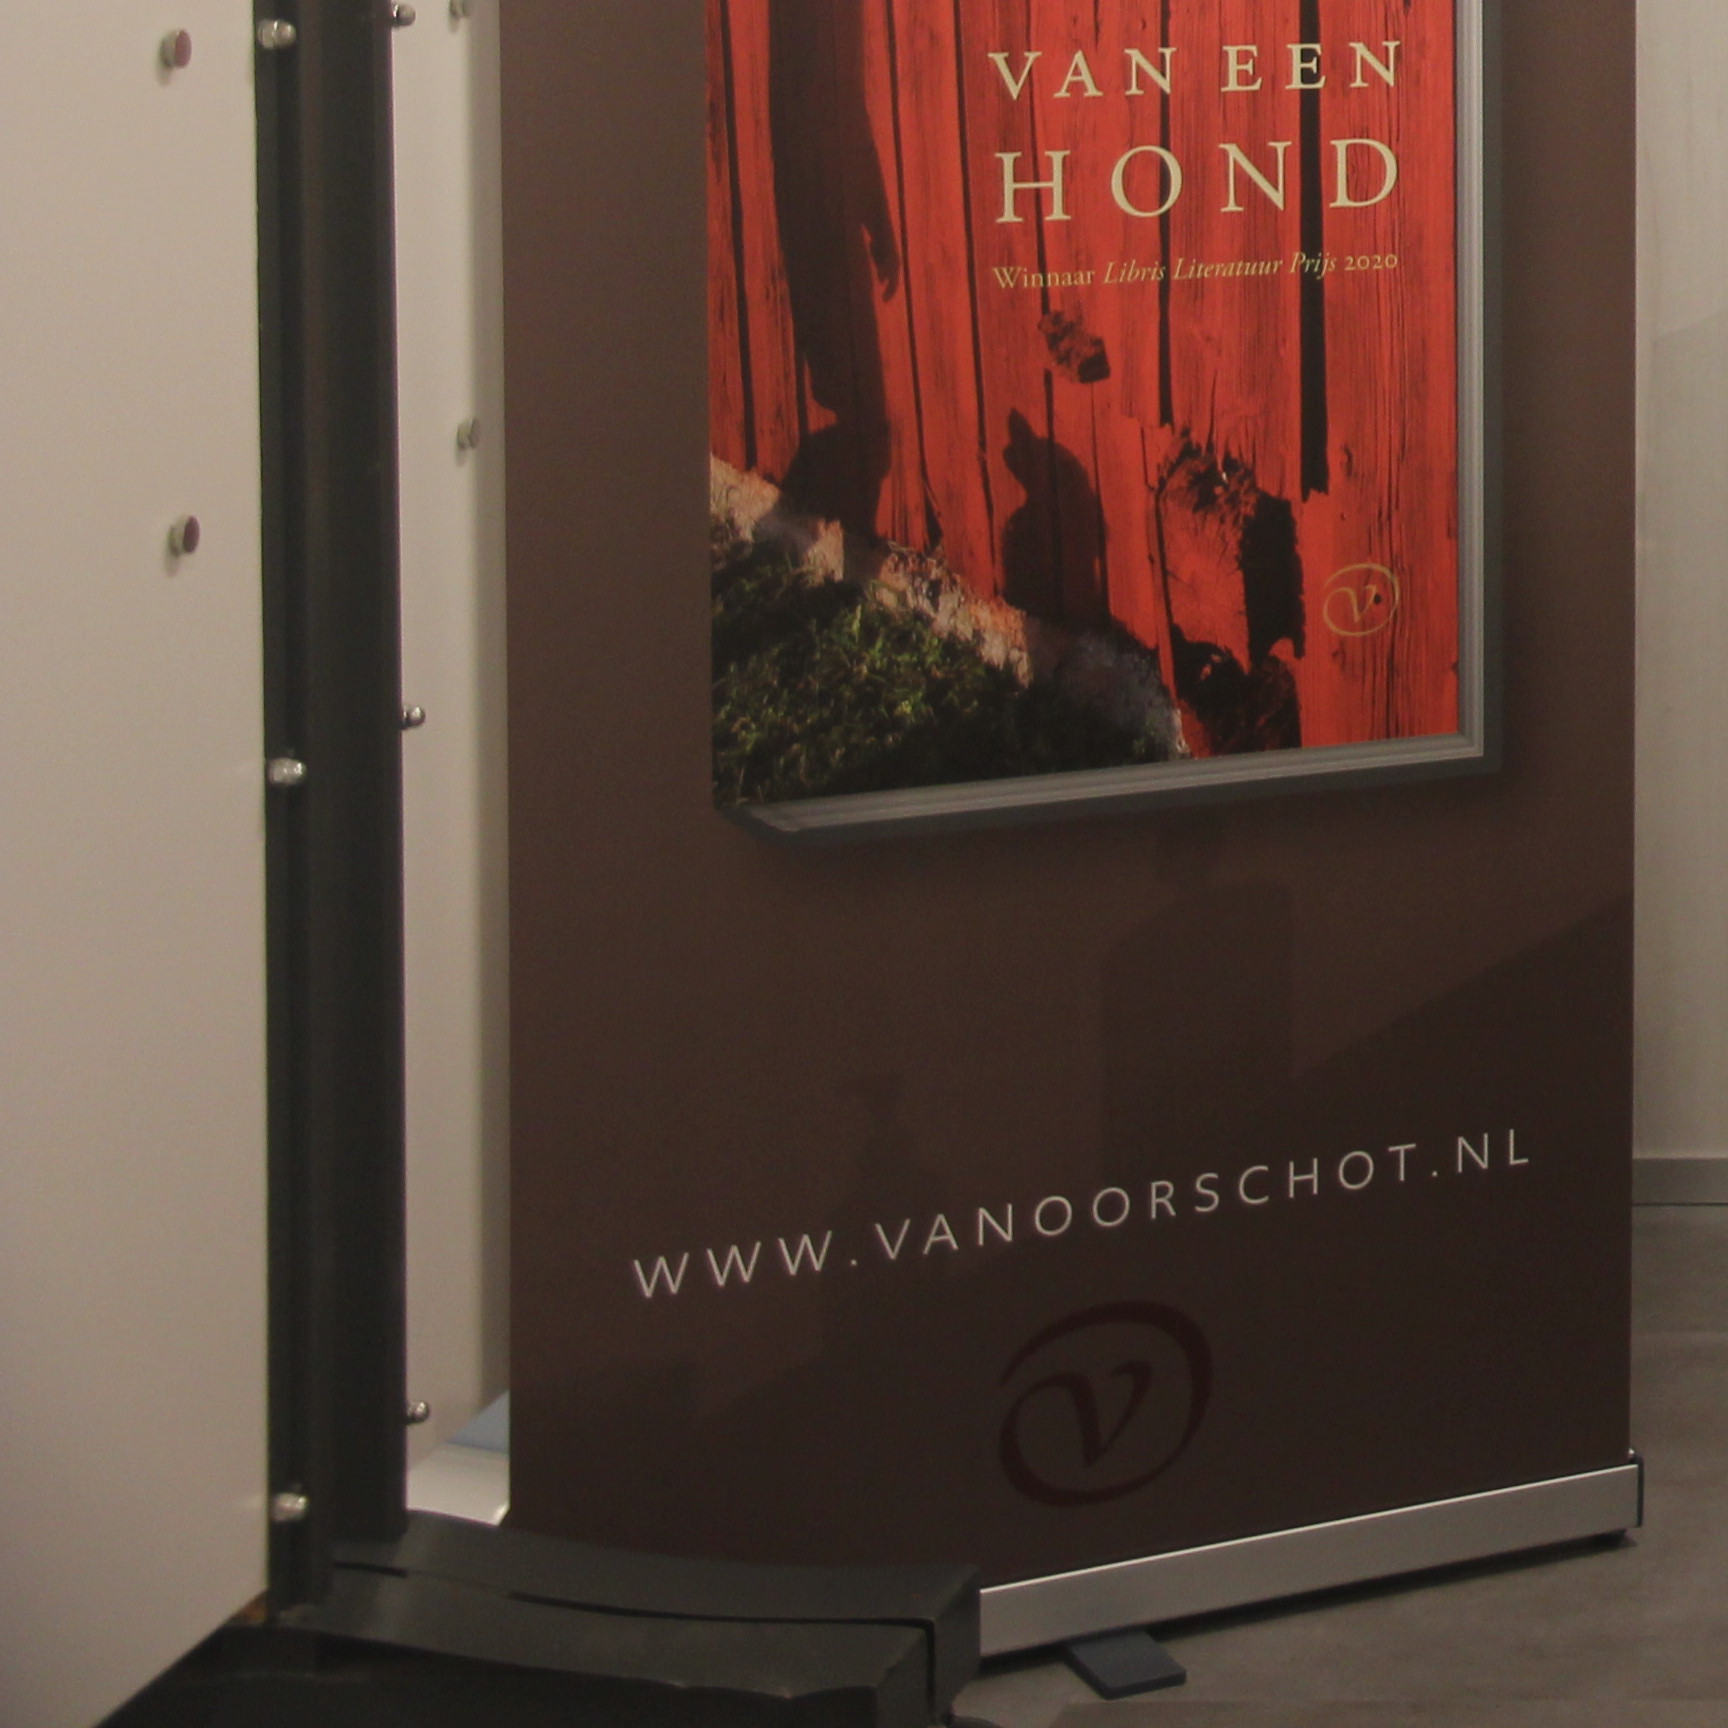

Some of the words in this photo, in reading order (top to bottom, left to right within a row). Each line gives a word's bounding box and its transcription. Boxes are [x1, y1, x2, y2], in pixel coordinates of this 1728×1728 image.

[988, 47, 1177, 101] VAN
[1221, 41, 1401, 92] EEN
[994, 138, 1398, 223] HOND
[992, 265, 1095, 291] Winnaar
[1103, 258, 1166, 286] Libris
[1174, 255, 1283, 281] Literatuur
[1290, 251, 1338, 280] Prijs
[1344, 252, 1398, 271] 2020
[634, 1128, 1530, 1300] WWW.VANOORSCHOT.NL
